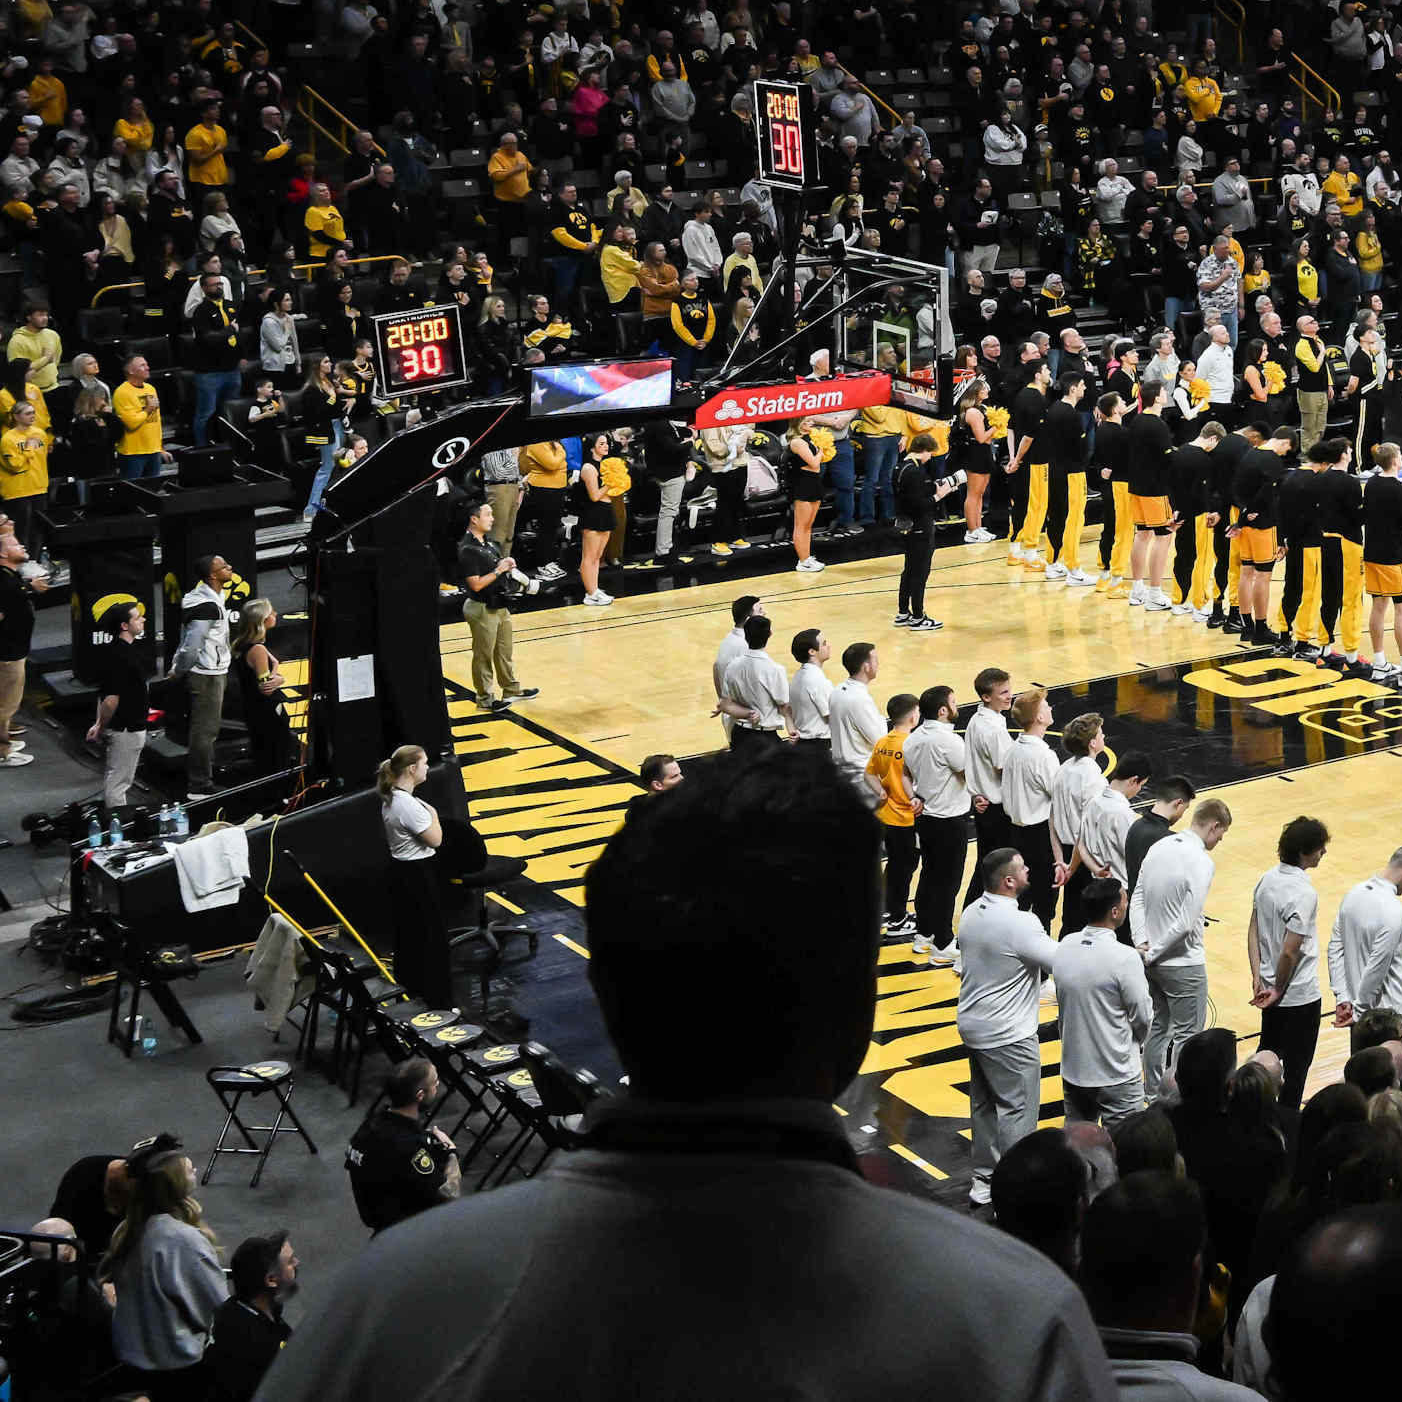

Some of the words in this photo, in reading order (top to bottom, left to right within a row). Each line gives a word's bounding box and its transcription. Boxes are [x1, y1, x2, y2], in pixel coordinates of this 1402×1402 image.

[767, 92, 800, 122] 20:00
[772, 123, 802, 175] 30
[386, 317, 449, 349] 20:00
[401, 344, 442, 380] 30
